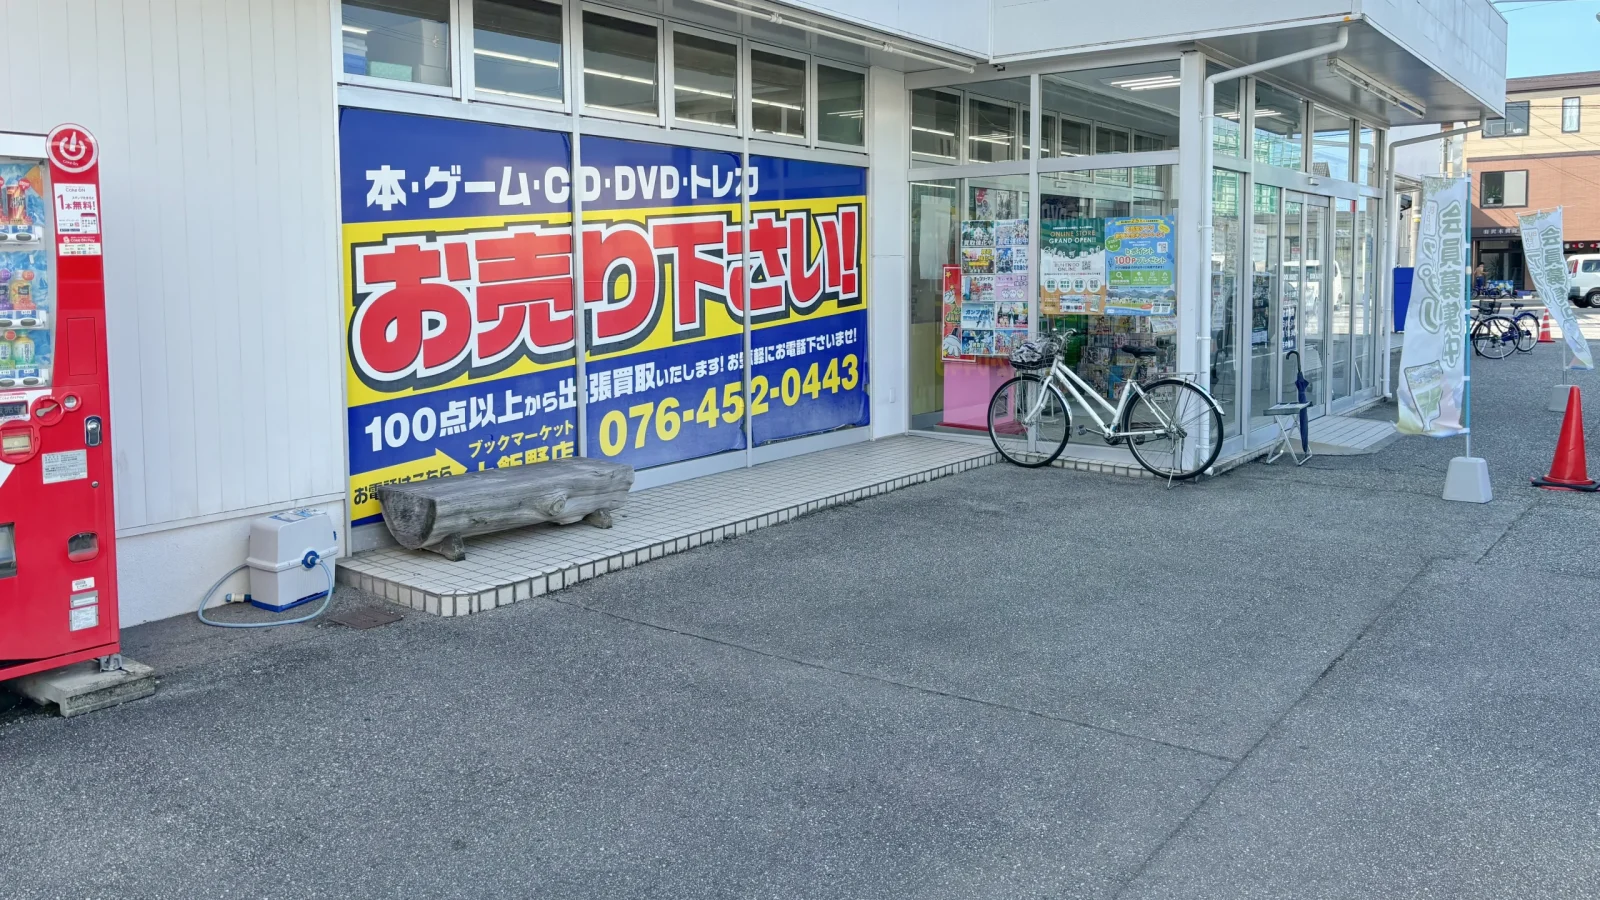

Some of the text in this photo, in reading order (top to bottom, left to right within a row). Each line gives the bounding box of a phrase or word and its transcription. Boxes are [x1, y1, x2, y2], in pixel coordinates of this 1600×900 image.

[57, 194, 96, 210] 1本無料!
[351, 205, 859, 383] お売り下さい!
[598, 353, 859, 457] 076-452-0443
[468, 420, 574, 458] ブックマーケット
[353, 465, 453, 505] お電ちら
